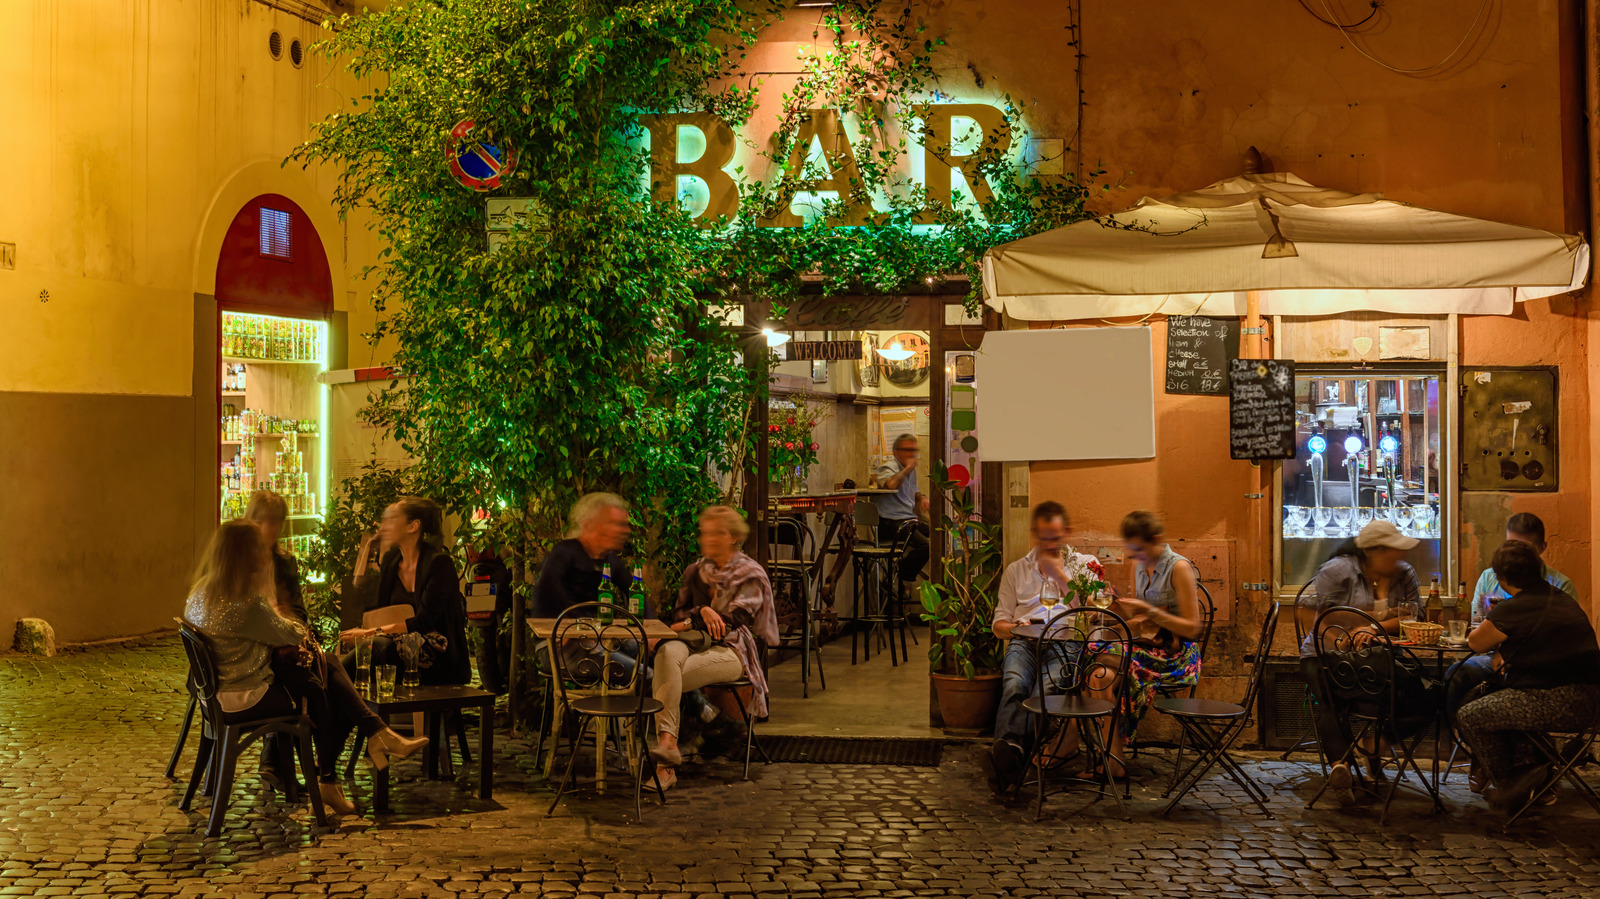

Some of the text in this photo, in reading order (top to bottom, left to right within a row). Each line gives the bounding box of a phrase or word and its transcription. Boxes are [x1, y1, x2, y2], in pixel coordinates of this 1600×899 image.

[638, 103, 1014, 228] BAR
[1170, 315, 1212, 328] We have
[1214, 325, 1229, 341] of
[793, 341, 856, 361] WELCOME
